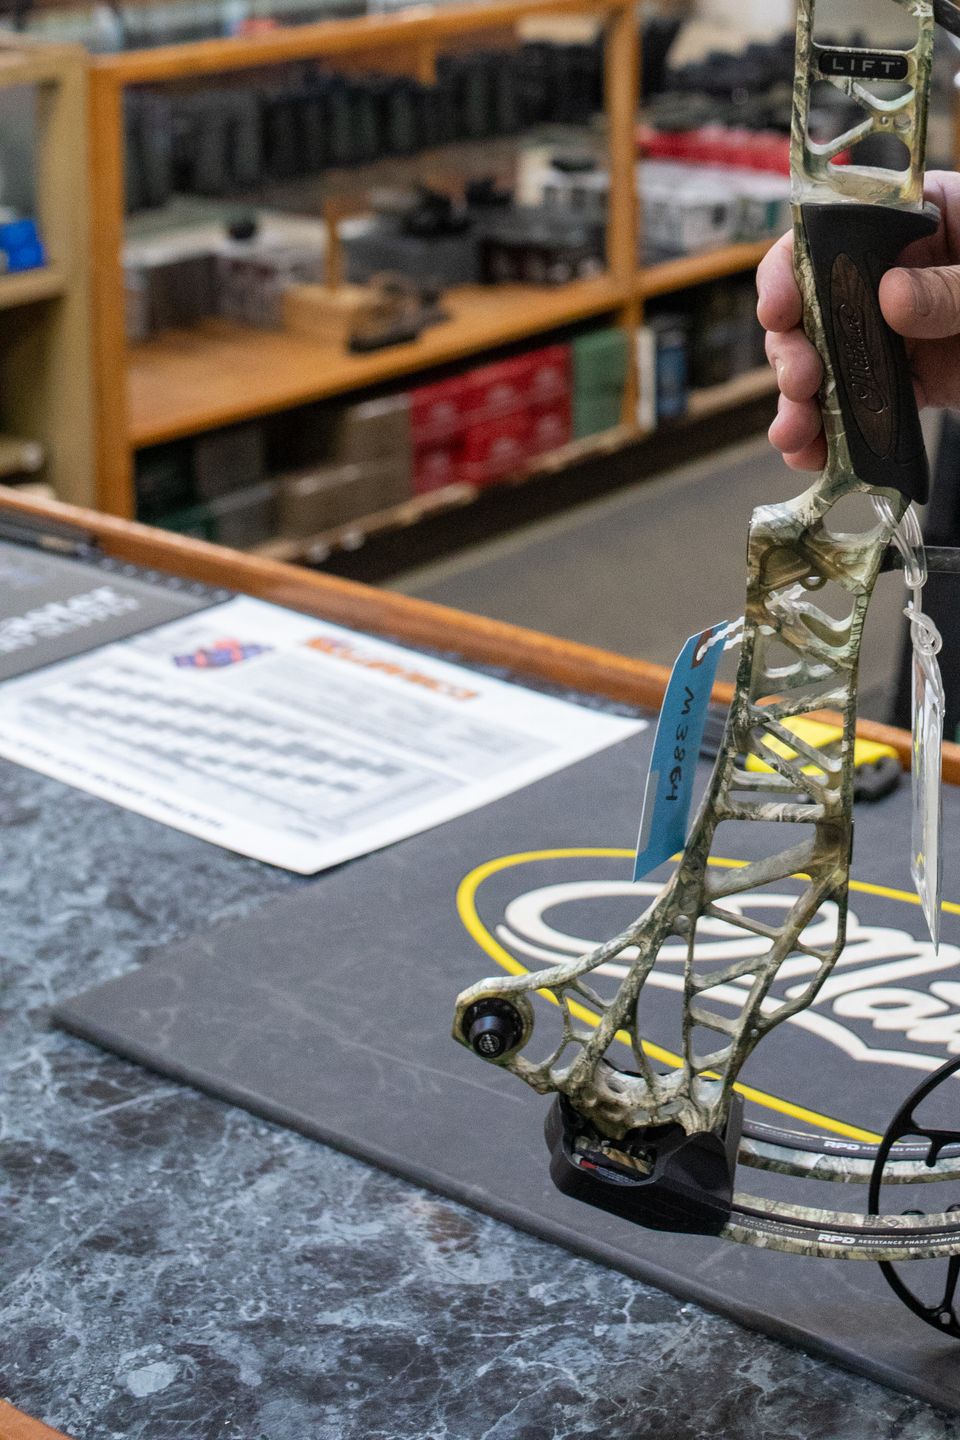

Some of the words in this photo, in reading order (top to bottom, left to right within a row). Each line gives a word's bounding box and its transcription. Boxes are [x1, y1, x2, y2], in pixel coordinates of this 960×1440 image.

[832, 56, 896, 74] LIFT
[823, 1140, 860, 1152] RPD
[817, 1233, 856, 1245] RPD
